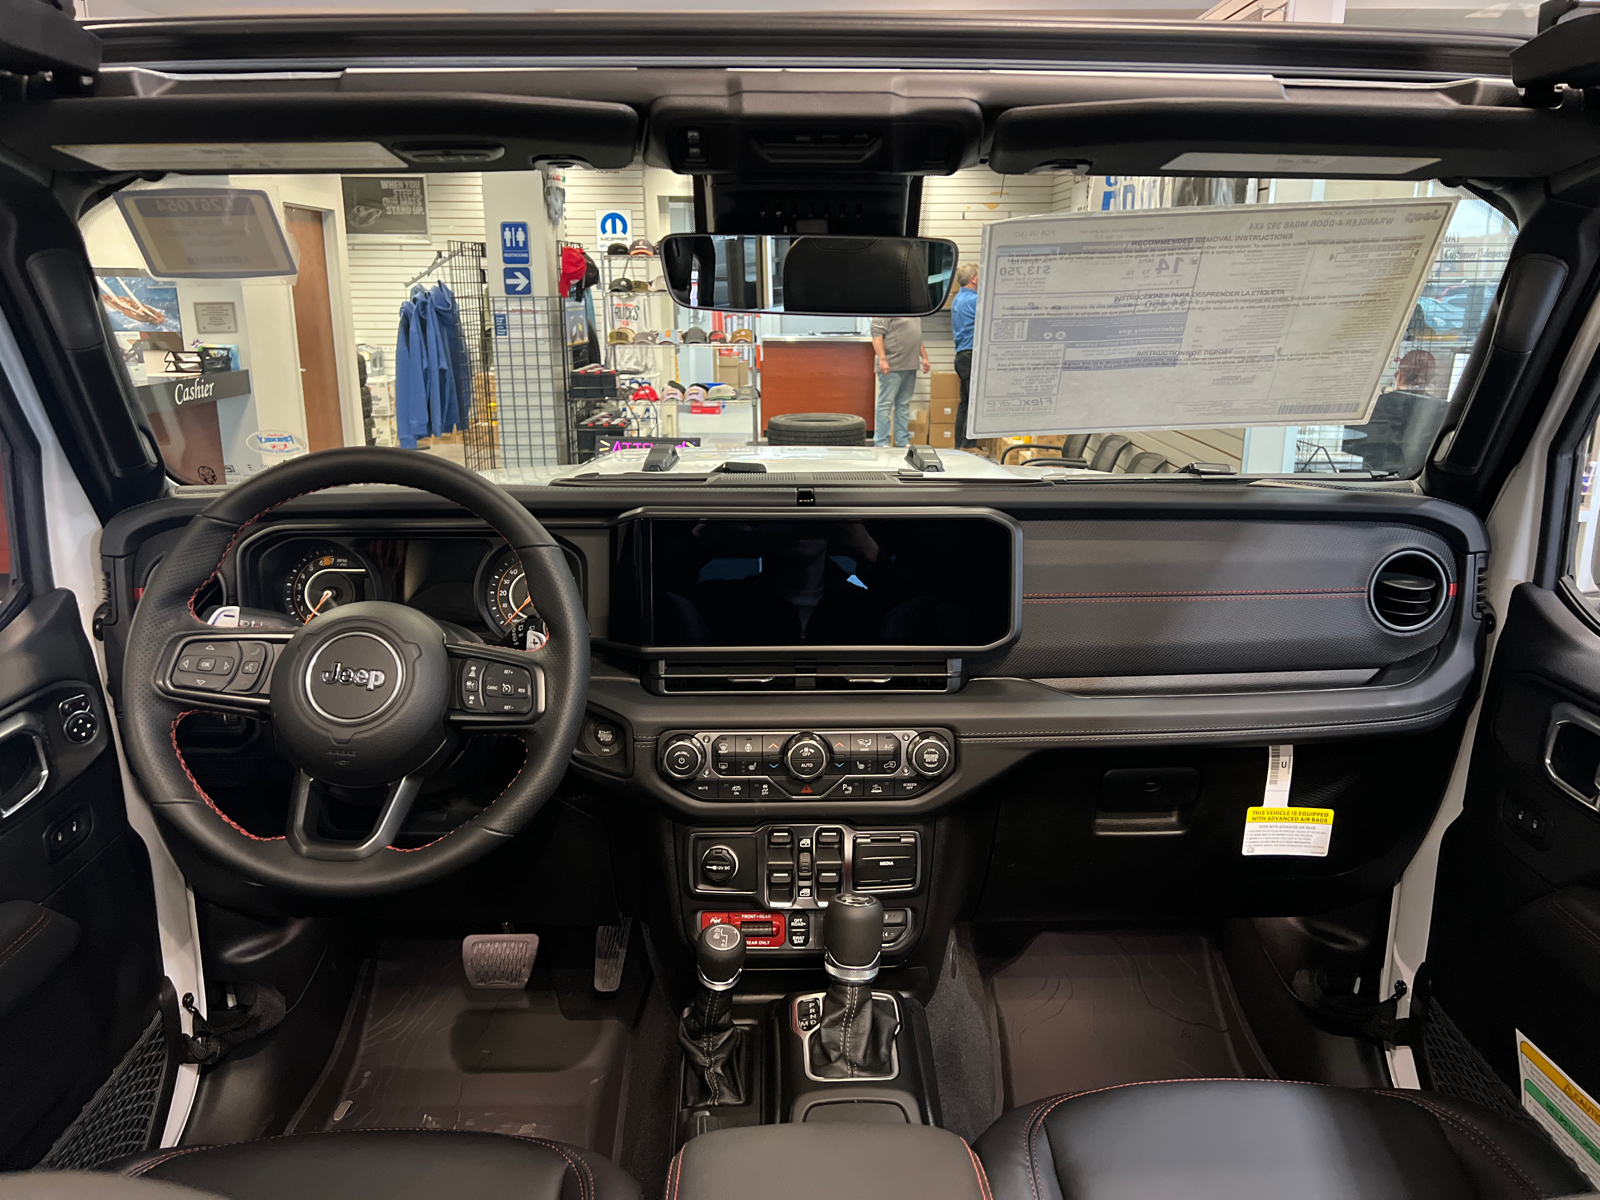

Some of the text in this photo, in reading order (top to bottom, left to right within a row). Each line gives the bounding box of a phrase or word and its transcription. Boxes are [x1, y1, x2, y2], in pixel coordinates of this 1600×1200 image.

[404, 181, 420, 189] YOU
[1132, 238, 1193, 246] RECOMMENDED
[1235, 233, 1294, 242] INSTRUCTIONS
[1444, 248, 1478, 259] Customer
[1114, 293, 1170, 302] INSTRUCCIONES
[1191, 290, 1240, 298] DESPRENDER
[175, 377, 215, 405] Cashier
[499, 589, 507, 597] 20
[321, 661, 386, 690] Jeep
